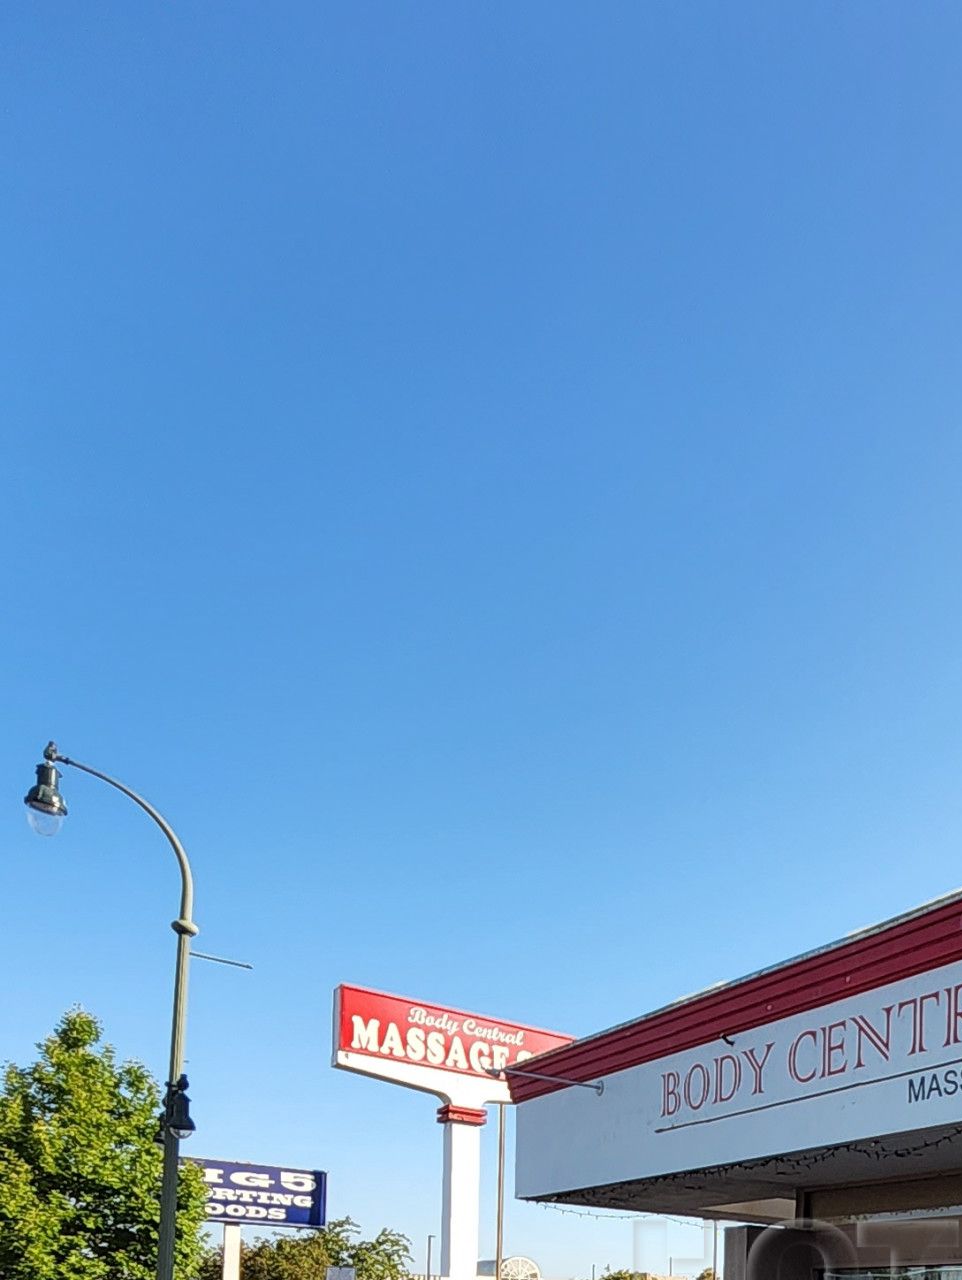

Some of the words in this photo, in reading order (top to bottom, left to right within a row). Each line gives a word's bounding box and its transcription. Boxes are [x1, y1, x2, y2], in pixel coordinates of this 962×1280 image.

[408, 1006, 460, 1035] Body
[462, 1018, 525, 1047] Central
[659, 1042, 775, 1118] BODY
[204, 1168, 275, 1188] IG
[281, 1171, 317, 1192] 5
[204, 1187, 314, 1208] RTING
[204, 1202, 287, 1219] OODS
